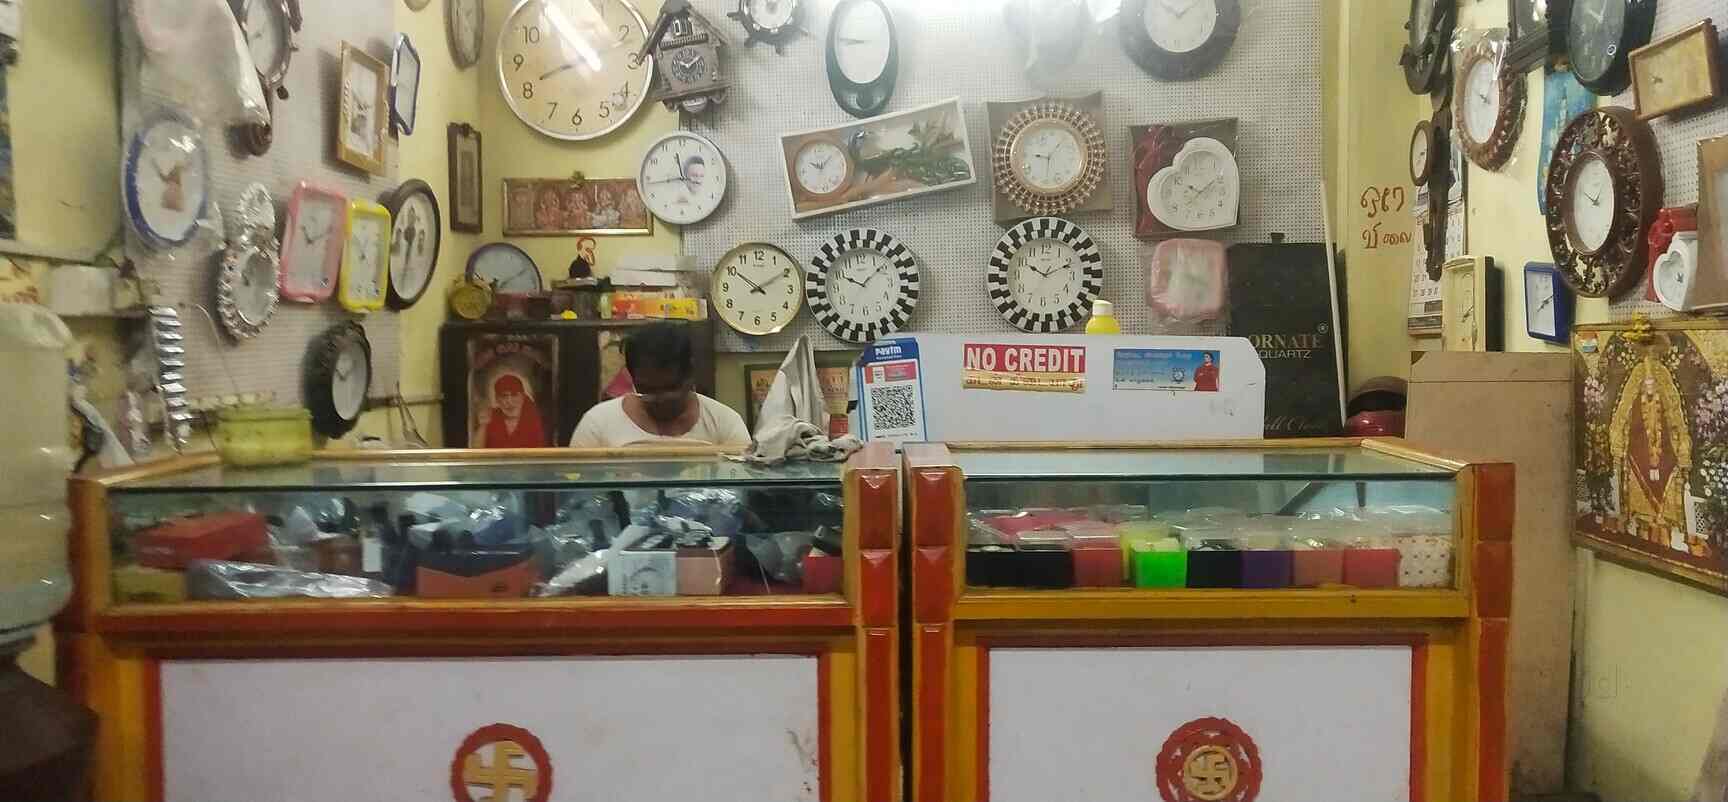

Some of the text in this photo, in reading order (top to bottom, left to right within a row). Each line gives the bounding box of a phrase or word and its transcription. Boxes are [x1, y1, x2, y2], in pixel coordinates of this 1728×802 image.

[522, 26, 540, 44] 10
[513, 54, 524, 71] 9
[522, 81, 534, 99] 8
[548, 102, 559, 120] 7
[599, 101, 610, 119] 5
[571, 108, 583, 126] 6
[739, 254, 747, 265] 11
[754, 250, 765, 261] 12
[773, 255, 777, 265] 1
[727, 266, 737, 277] 10
[783, 268, 790, 278] 2
[722, 282, 729, 292] 9
[787, 285, 794, 295] 3
[726, 298, 733, 309] 8
[782, 301, 789, 310] 4
[738, 311, 744, 321] 7
[754, 315, 761, 326] 6
[770, 312, 777, 322] 5
[1248, 334, 1323, 349] ORNATE
[967, 347, 1084, 373] NO CREDIT
[1258, 349, 1313, 360] QUARTZ
